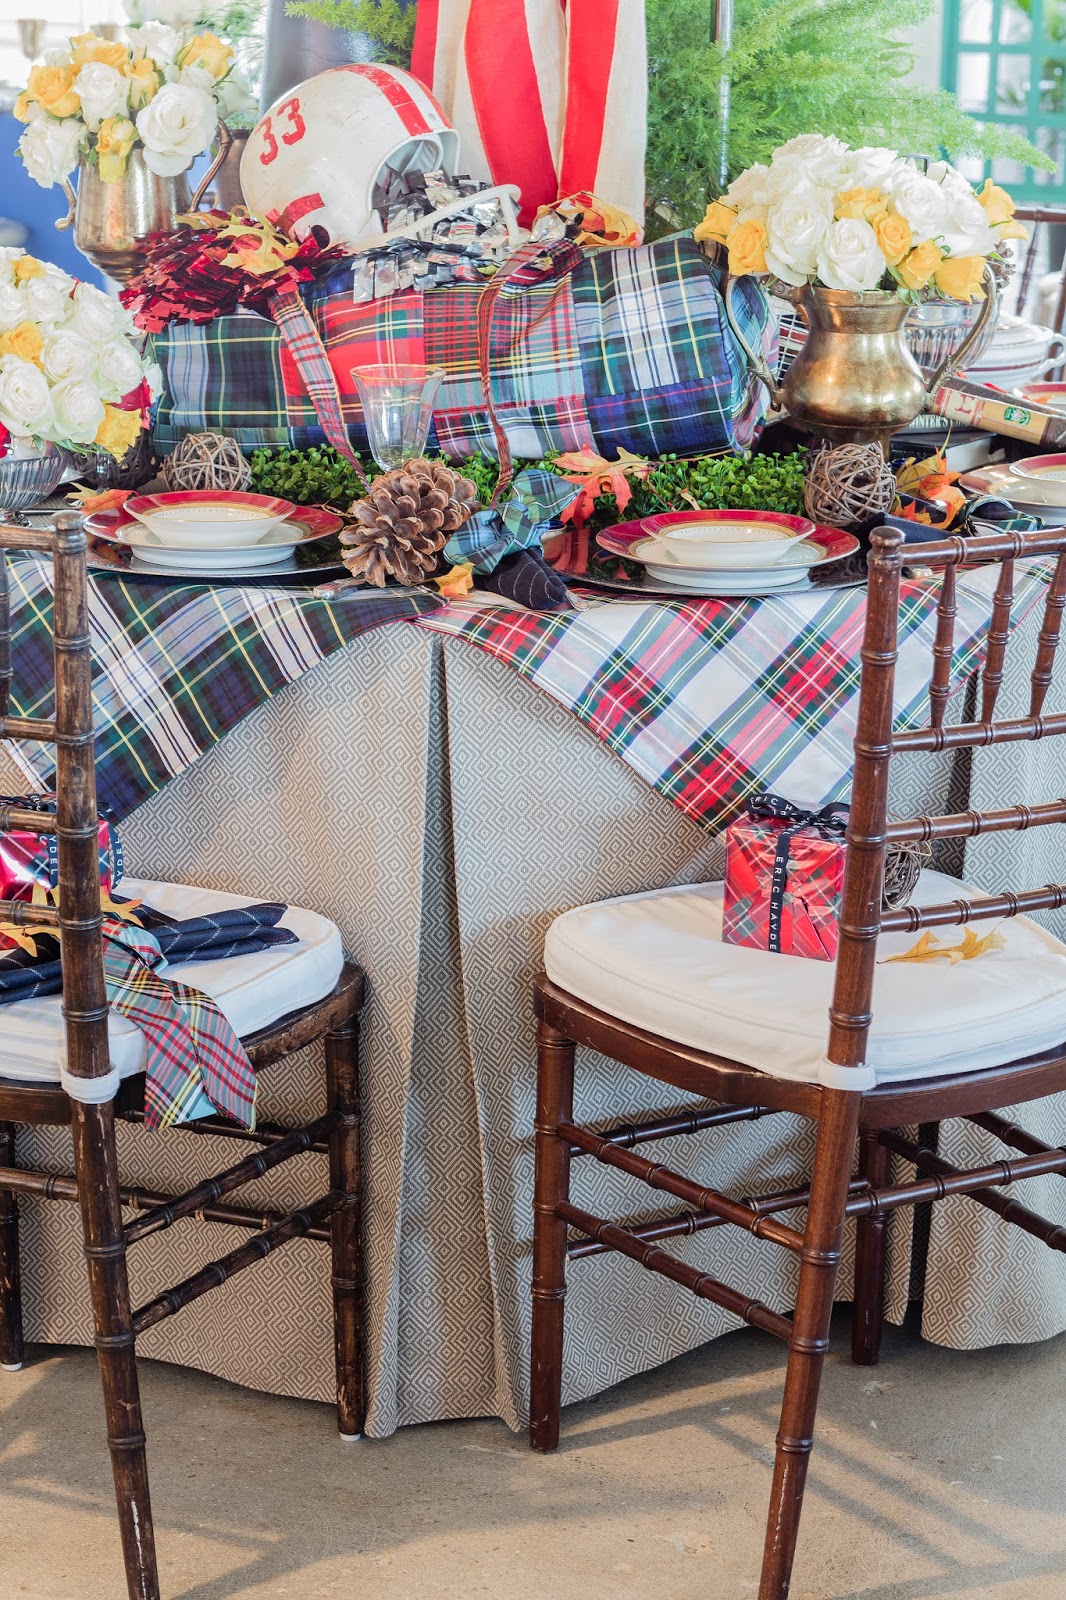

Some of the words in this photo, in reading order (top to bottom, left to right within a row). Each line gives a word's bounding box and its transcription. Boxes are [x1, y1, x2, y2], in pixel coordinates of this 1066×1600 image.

[255, 98, 306, 166] 33
[773, 856, 783, 894] ERIC
[770, 902, 778, 950] HAYDE
